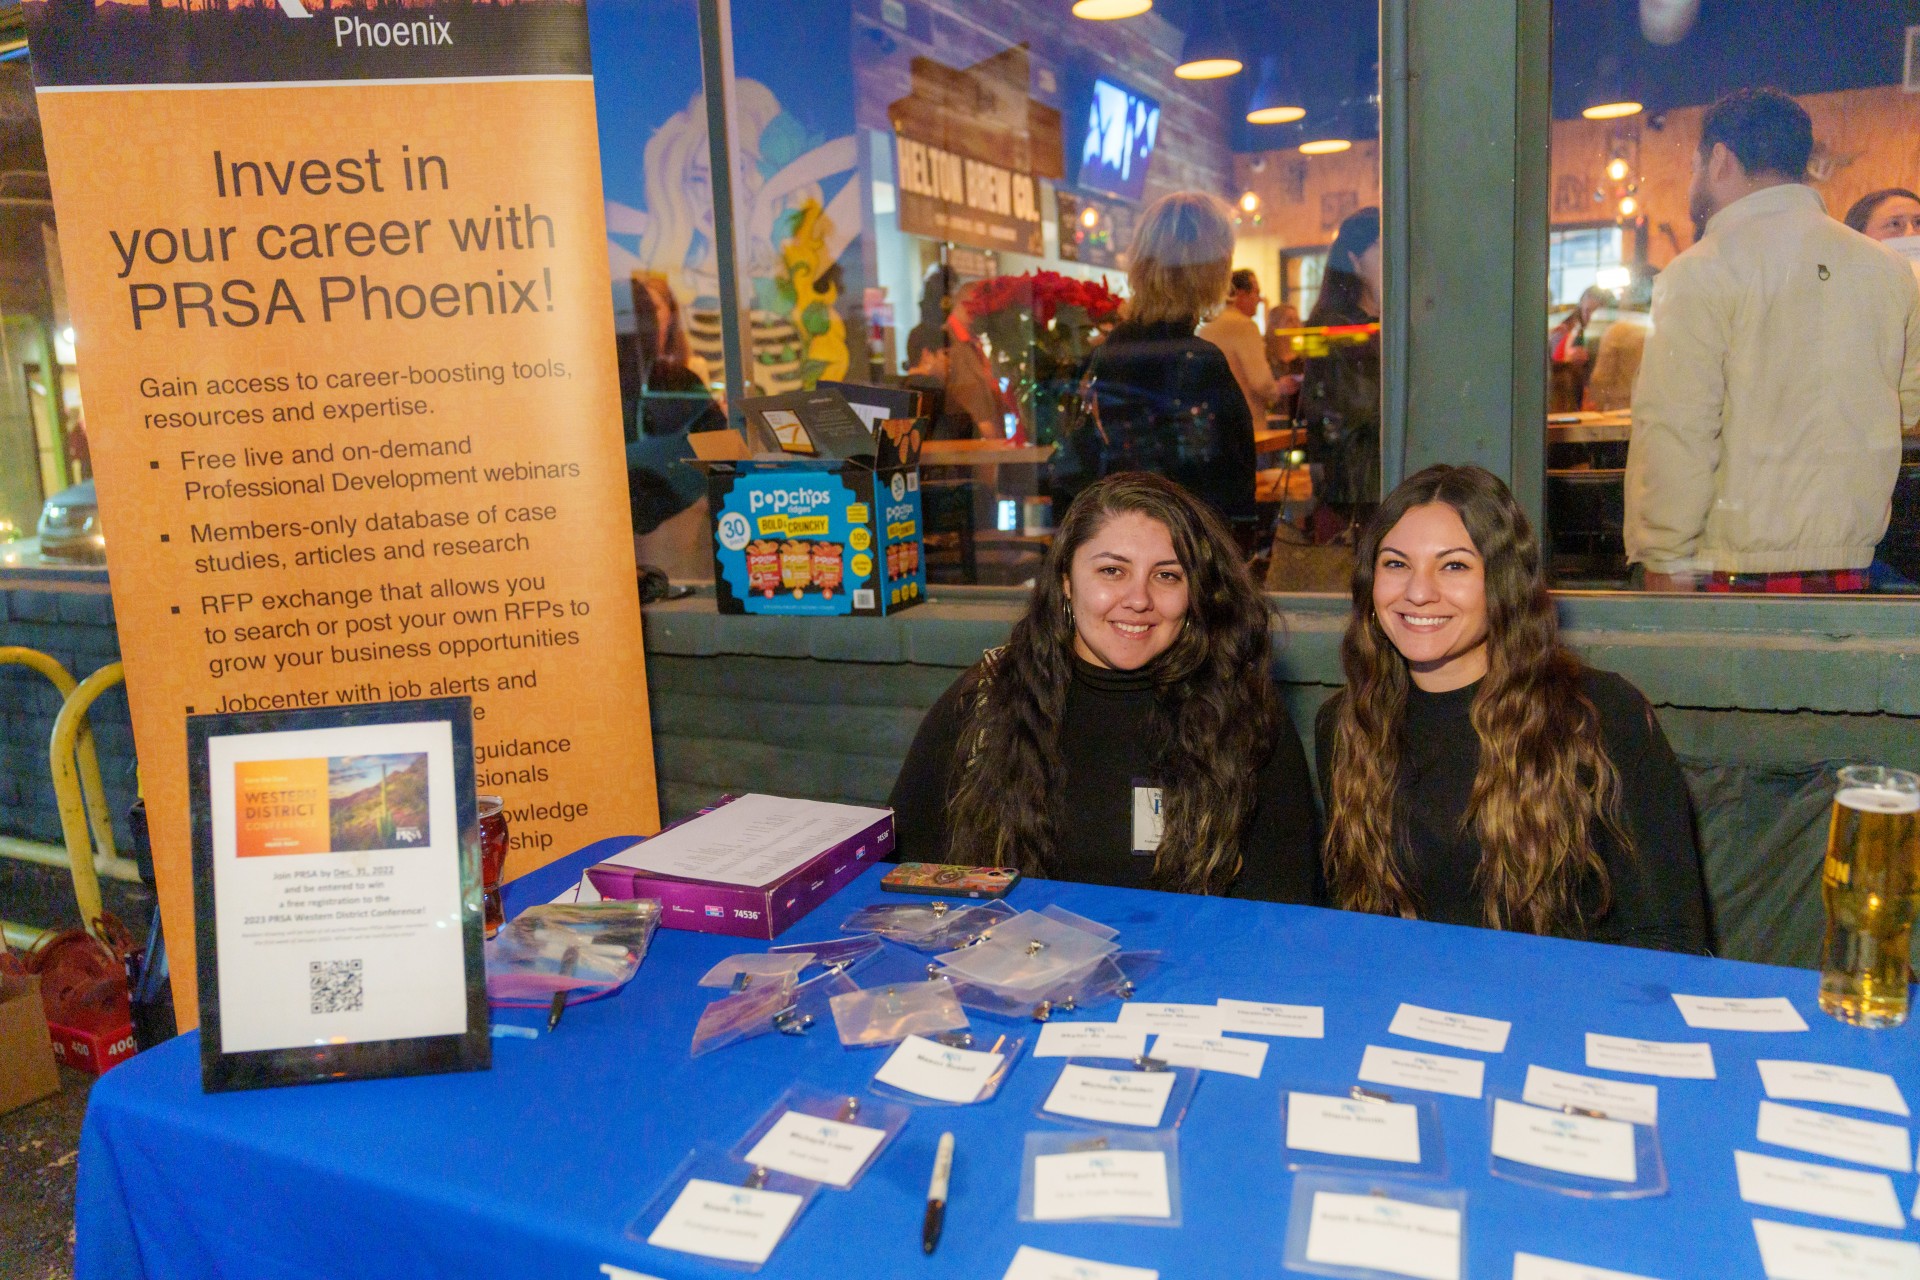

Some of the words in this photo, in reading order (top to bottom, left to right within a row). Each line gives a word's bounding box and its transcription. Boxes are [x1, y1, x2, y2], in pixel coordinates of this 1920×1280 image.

[335, 15, 453, 47] Phoenix
[214, 149, 384, 197] Invest
[403, 145, 448, 190] in
[110, 227, 236, 278] your
[257, 220, 430, 260] career
[449, 204, 553, 251] with
[130, 279, 305, 330] PRSA
[320, 268, 554, 322] Phoenix!
[140, 377, 197, 398] Gain
[207, 377, 289, 395] access
[296, 373, 318, 390] to
[326, 364, 504, 388] career-boosting
[512, 359, 572, 380] tools,
[145, 409, 264, 429] resources
[273, 402, 314, 422] and
[323, 399, 433, 423] expertise.
[181, 451, 235, 470] Free
[245, 448, 283, 466] live
[292, 443, 333, 464] and
[342, 436, 471, 461] on-demand
[185, 474, 324, 500] Professional
[332, 466, 477, 491] Development
[484, 462, 579, 482] webinars
[749, 488, 830, 513] popchips
[191, 515, 356, 543] Members-only
[365, 510, 469, 531] database
[477, 505, 496, 524] of
[505, 506, 556, 522] case
[724, 519, 745, 538] 30
[762, 519, 782, 530] BOLD
[788, 520, 825, 533] CRUNCHY
[853, 533, 867, 541] 100
[195, 552, 286, 573] studies,
[295, 545, 375, 566] articles
[384, 540, 424, 560] and
[433, 533, 529, 556] research
[201, 593, 253, 614] RFP
[262, 589, 372, 610] exchange
[380, 582, 422, 601] that
[431, 579, 499, 597] allows
[506, 577, 545, 597] you
[205, 628, 226, 644] to
[235, 619, 309, 642] search
[317, 621, 338, 635] or
[346, 614, 392, 637] post
[399, 613, 445, 633] your
[453, 609, 497, 625] own
[505, 601, 564, 620] RFPs
[570, 600, 589, 616] to
[209, 655, 266, 678] grow
[274, 651, 323, 672] your
[331, 643, 431, 663] business
[439, 629, 580, 656] opportunities
[215, 690, 328, 713] Jobcenter
[336, 684, 380, 701] with
[387, 680, 422, 700] job
[431, 676, 489, 693] alerts
[498, 670, 536, 690] and
[475, 737, 570, 762] guidance
[476, 765, 549, 787] sionals
[245, 804, 315, 819] DISTRICT
[503, 802, 588, 823] owledge
[284, 885, 300, 893] and
[304, 883, 315, 892] be
[318, 882, 353, 892] entered
[356, 882, 365, 890] to
[368, 881, 384, 889] win
[287, 899, 305, 908] free
[308, 896, 360, 908] registration
[363, 895, 372, 903] to
[375, 894, 390, 902] the
[295, 912, 333, 921] Western
[336, 909, 368, 919] District
[734, 909, 758, 920] 74536
[108, 1035, 134, 1056] 400
